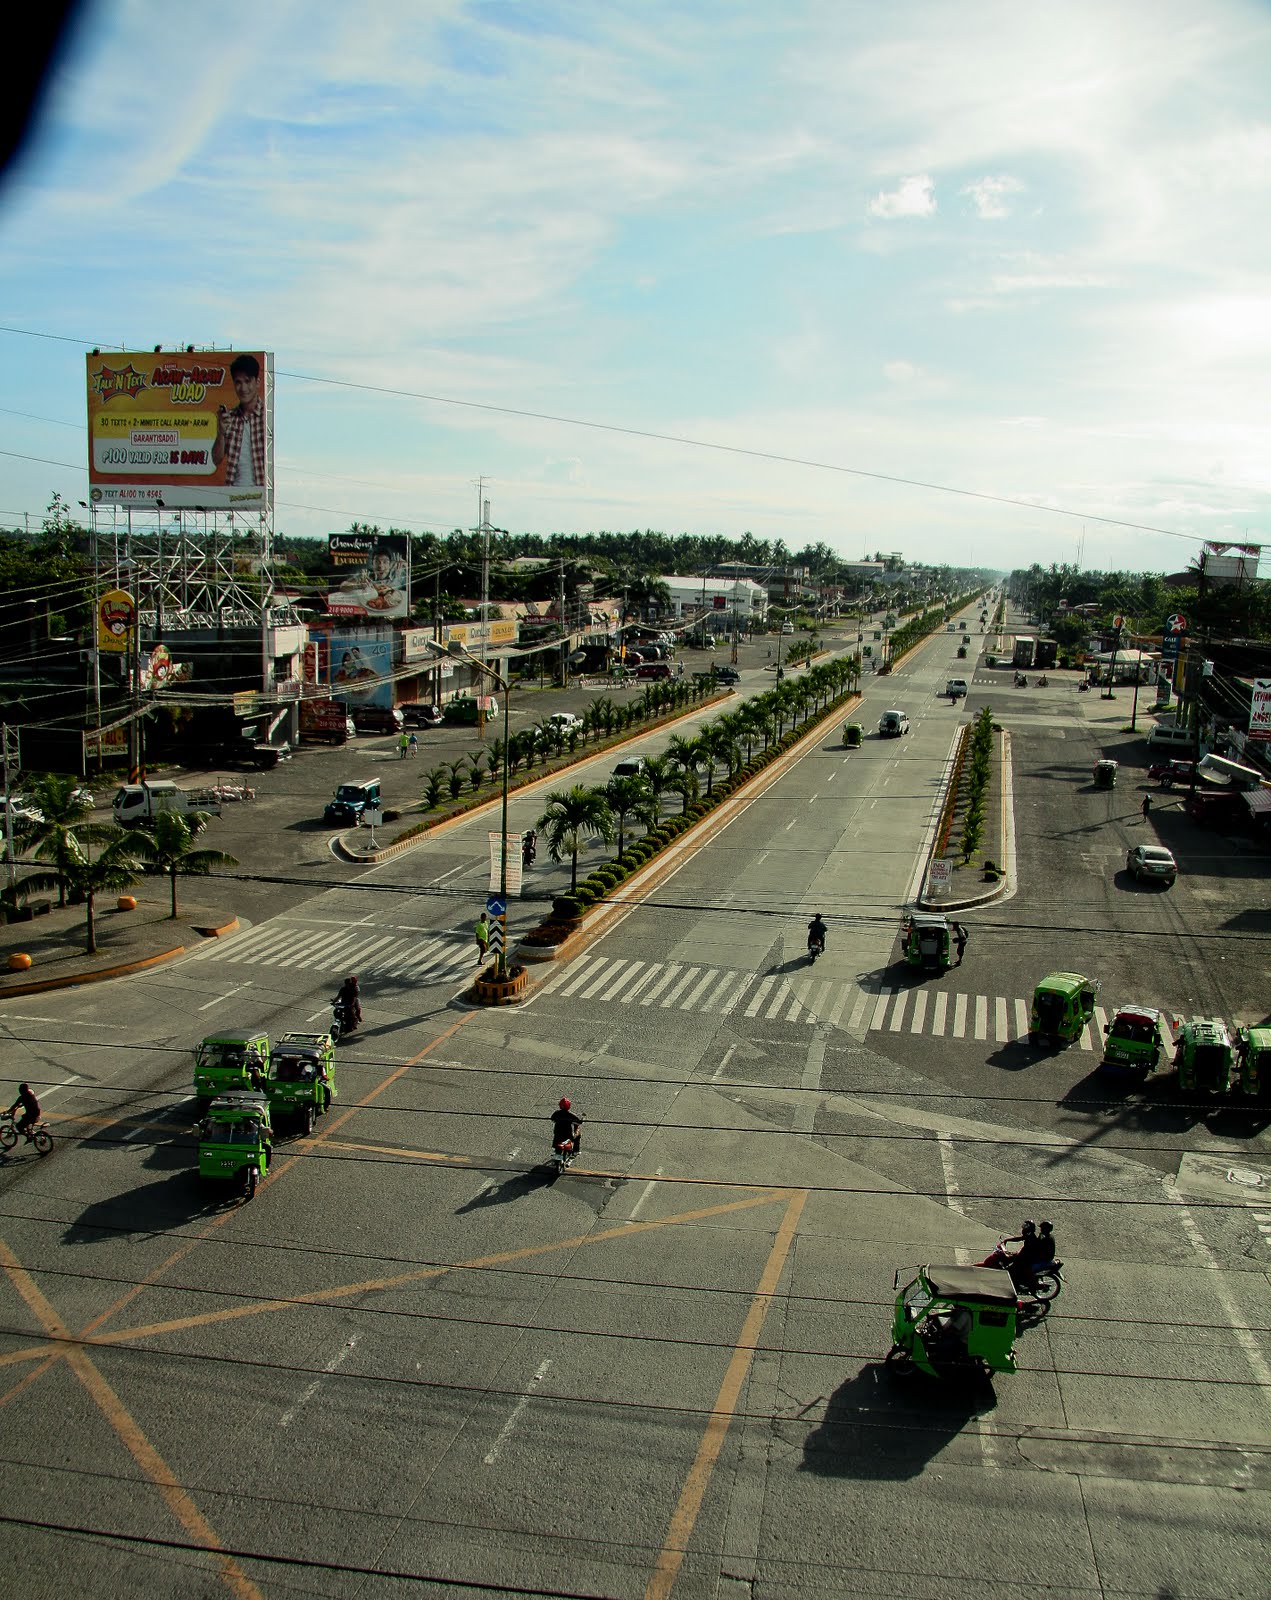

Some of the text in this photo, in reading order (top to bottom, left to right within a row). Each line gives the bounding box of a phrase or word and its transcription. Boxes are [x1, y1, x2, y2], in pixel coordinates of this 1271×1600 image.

[171, 383, 205, 401] LOAD
[110, 418, 127, 427] TEXTS
[160, 418, 173, 427] CALL
[129, 451, 152, 465] VALID
[152, 451, 169, 465] FOR
[105, 490, 118, 498] TEXT
[138, 490, 146, 498] TO
[330, 537, 373, 550] Chowking
[333, 555, 368, 566] LAURIAT
